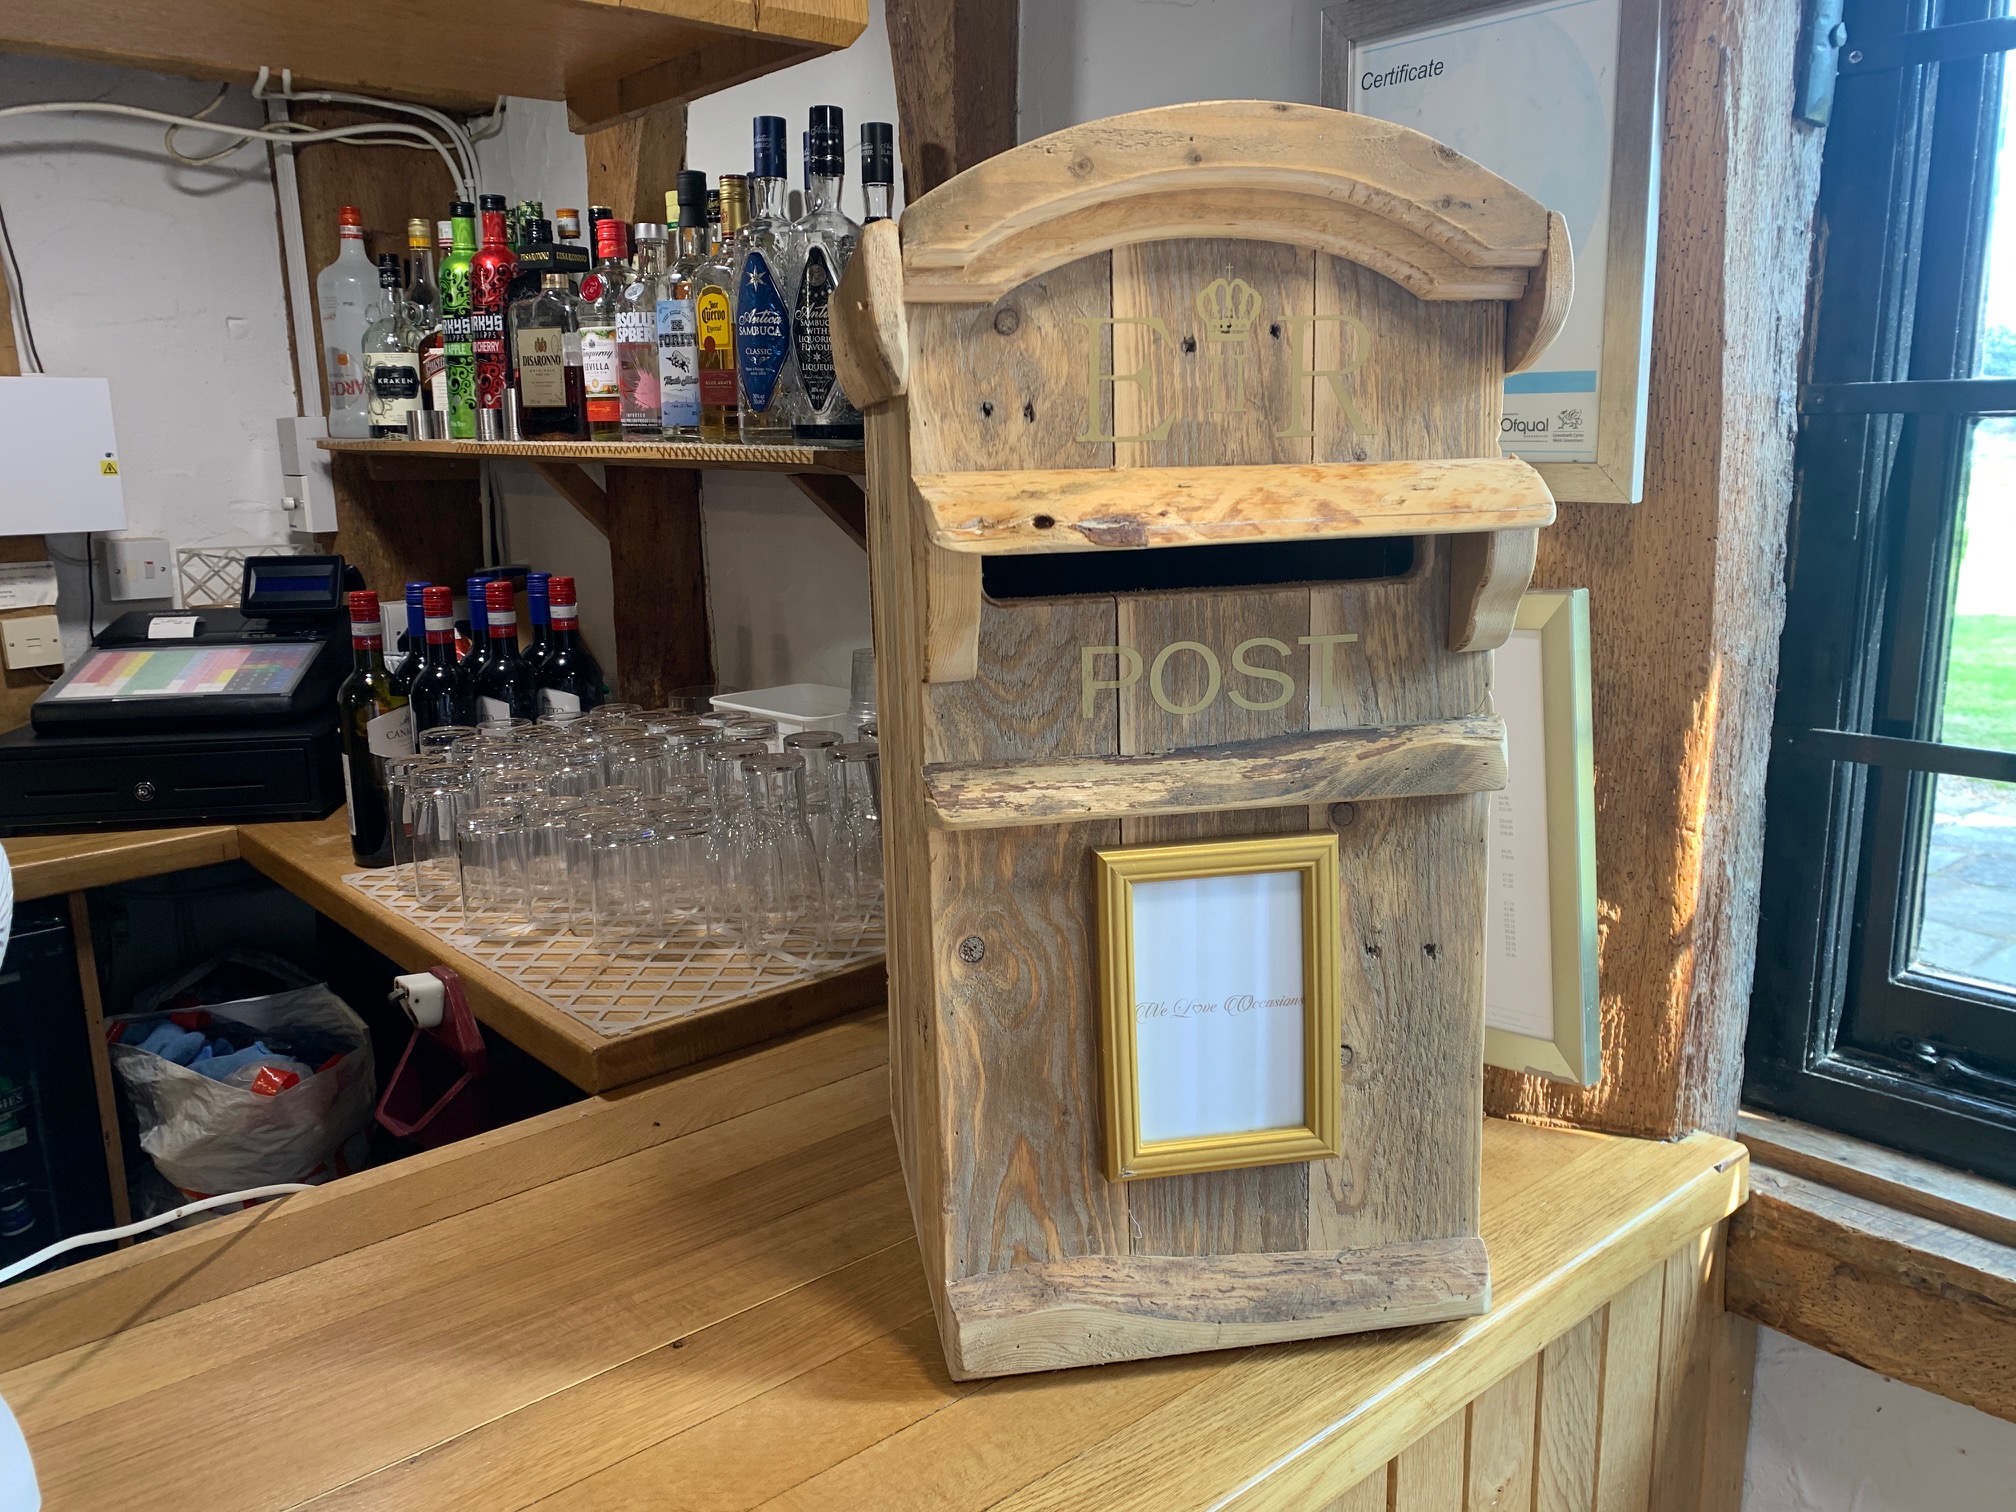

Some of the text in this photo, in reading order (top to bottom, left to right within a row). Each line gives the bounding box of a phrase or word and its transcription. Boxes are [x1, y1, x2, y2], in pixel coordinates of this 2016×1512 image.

[1361, 59, 1444, 90] Certificate
[616, 311, 657, 327] BSOLUT
[702, 308, 726, 324] Cuervo
[738, 308, 782, 325] Antica
[795, 302, 829, 320] Anti
[442, 316, 470, 334] RKY'S
[471, 313, 503, 332] RKY'S
[670, 319, 684, 331] EL
[616, 327, 657, 343] SPBER
[738, 326, 783, 337] SAMBUCA
[798, 335, 832, 343] LIQUORIC
[477, 341, 500, 352] CHERRY
[582, 348, 613, 359] nqueray
[745, 347, 773, 355] CLASSIC
[522, 354, 561, 367] DISARONNO
[802, 362, 835, 372] LIQUEUR
[1500, 417, 1549, 435] Ofqual
[1081, 633, 1358, 719] POST
[1136, 1001, 1168, 1024] We
[1223, 994, 1304, 1017] Occasions
